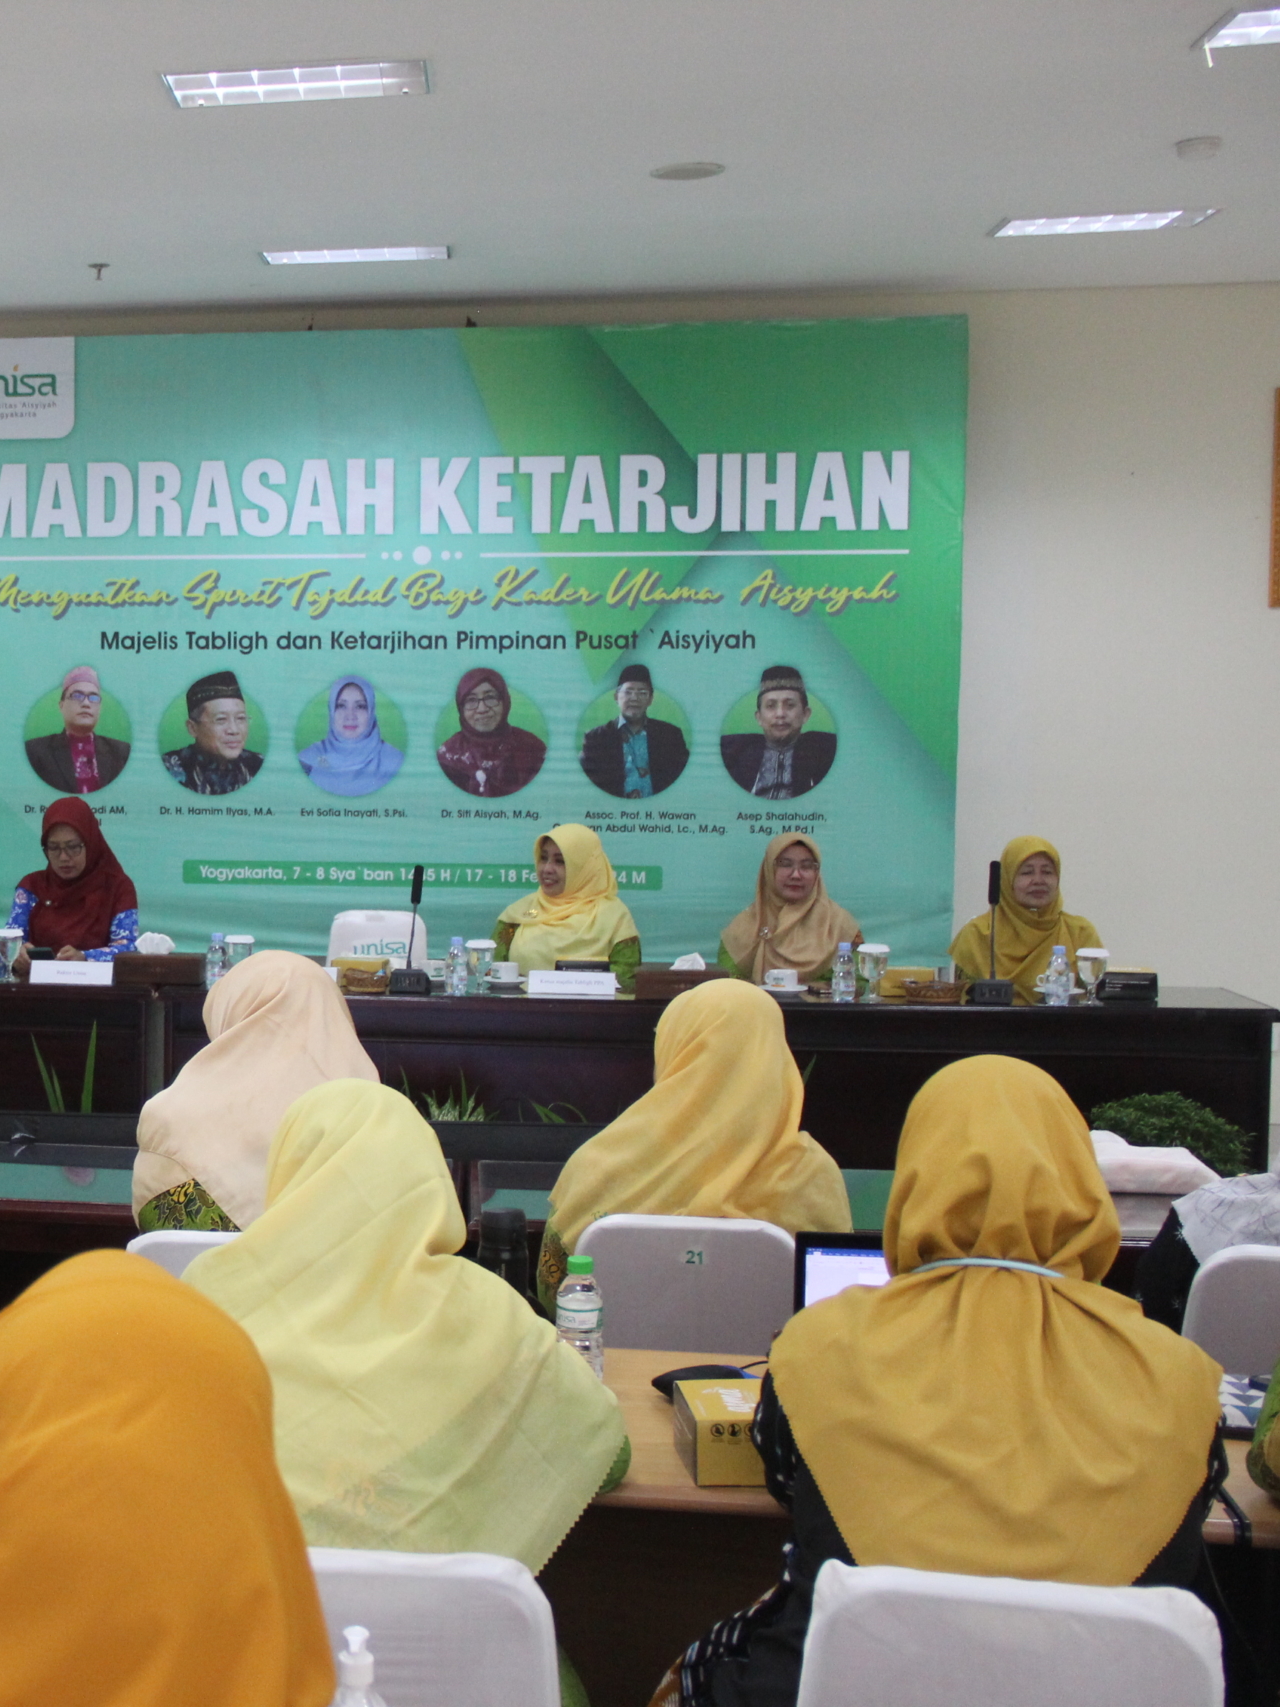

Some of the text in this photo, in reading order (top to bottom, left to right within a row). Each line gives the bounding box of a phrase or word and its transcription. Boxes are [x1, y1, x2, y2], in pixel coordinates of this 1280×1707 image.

[420, 450, 911, 534] KETARJIHAN
[181, 569, 284, 619] Spirit
[283, 568, 398, 620] Tajdid
[400, 568, 484, 619] Bagi
[490, 565, 600, 611] Kader
[606, 567, 724, 610] Ulama
[740, 568, 900, 617] Aisyiyah
[100, 631, 178, 653] Majelis
[185, 631, 268, 654] Tabligh
[276, 631, 322, 650] dan
[330, 630, 448, 653] Ketarjihan
[456, 630, 566, 653] Pimpinan
[575, 630, 639, 650] Pusat
[24, 805, 36, 814] Dr.
[109, 806, 127, 816] AM,
[159, 806, 276, 818] Dr. H. Hamim Ilyas, M.A.
[300, 808, 408, 819] Evi Sofia Inayati, S.Psi.
[441, 809, 542, 821] Dr. Siti Aisyah, M.Ag.
[585, 811, 697, 821] Assoc. Prof. H. Wawan
[736, 812, 827, 823] Asep Shalahudin,
[605, 824, 636, 833] Abdul
[639, 824, 674, 834] Wahid,
[677, 824, 696, 835] Lc.,
[698, 825, 729, 836] M.Ag.
[749, 825, 779, 836] S.Ag.,
[200, 865, 287, 882] Yogyakarta,
[292, 866, 301, 880] 7
[315, 867, 325, 881] 8
[440, 868, 451, 882] H
[454, 868, 461, 884] /
[465, 868, 483, 882] 17
[499, 869, 517, 883] 18
[631, 870, 646, 884] M
[685, 1250, 703, 1265] 21
